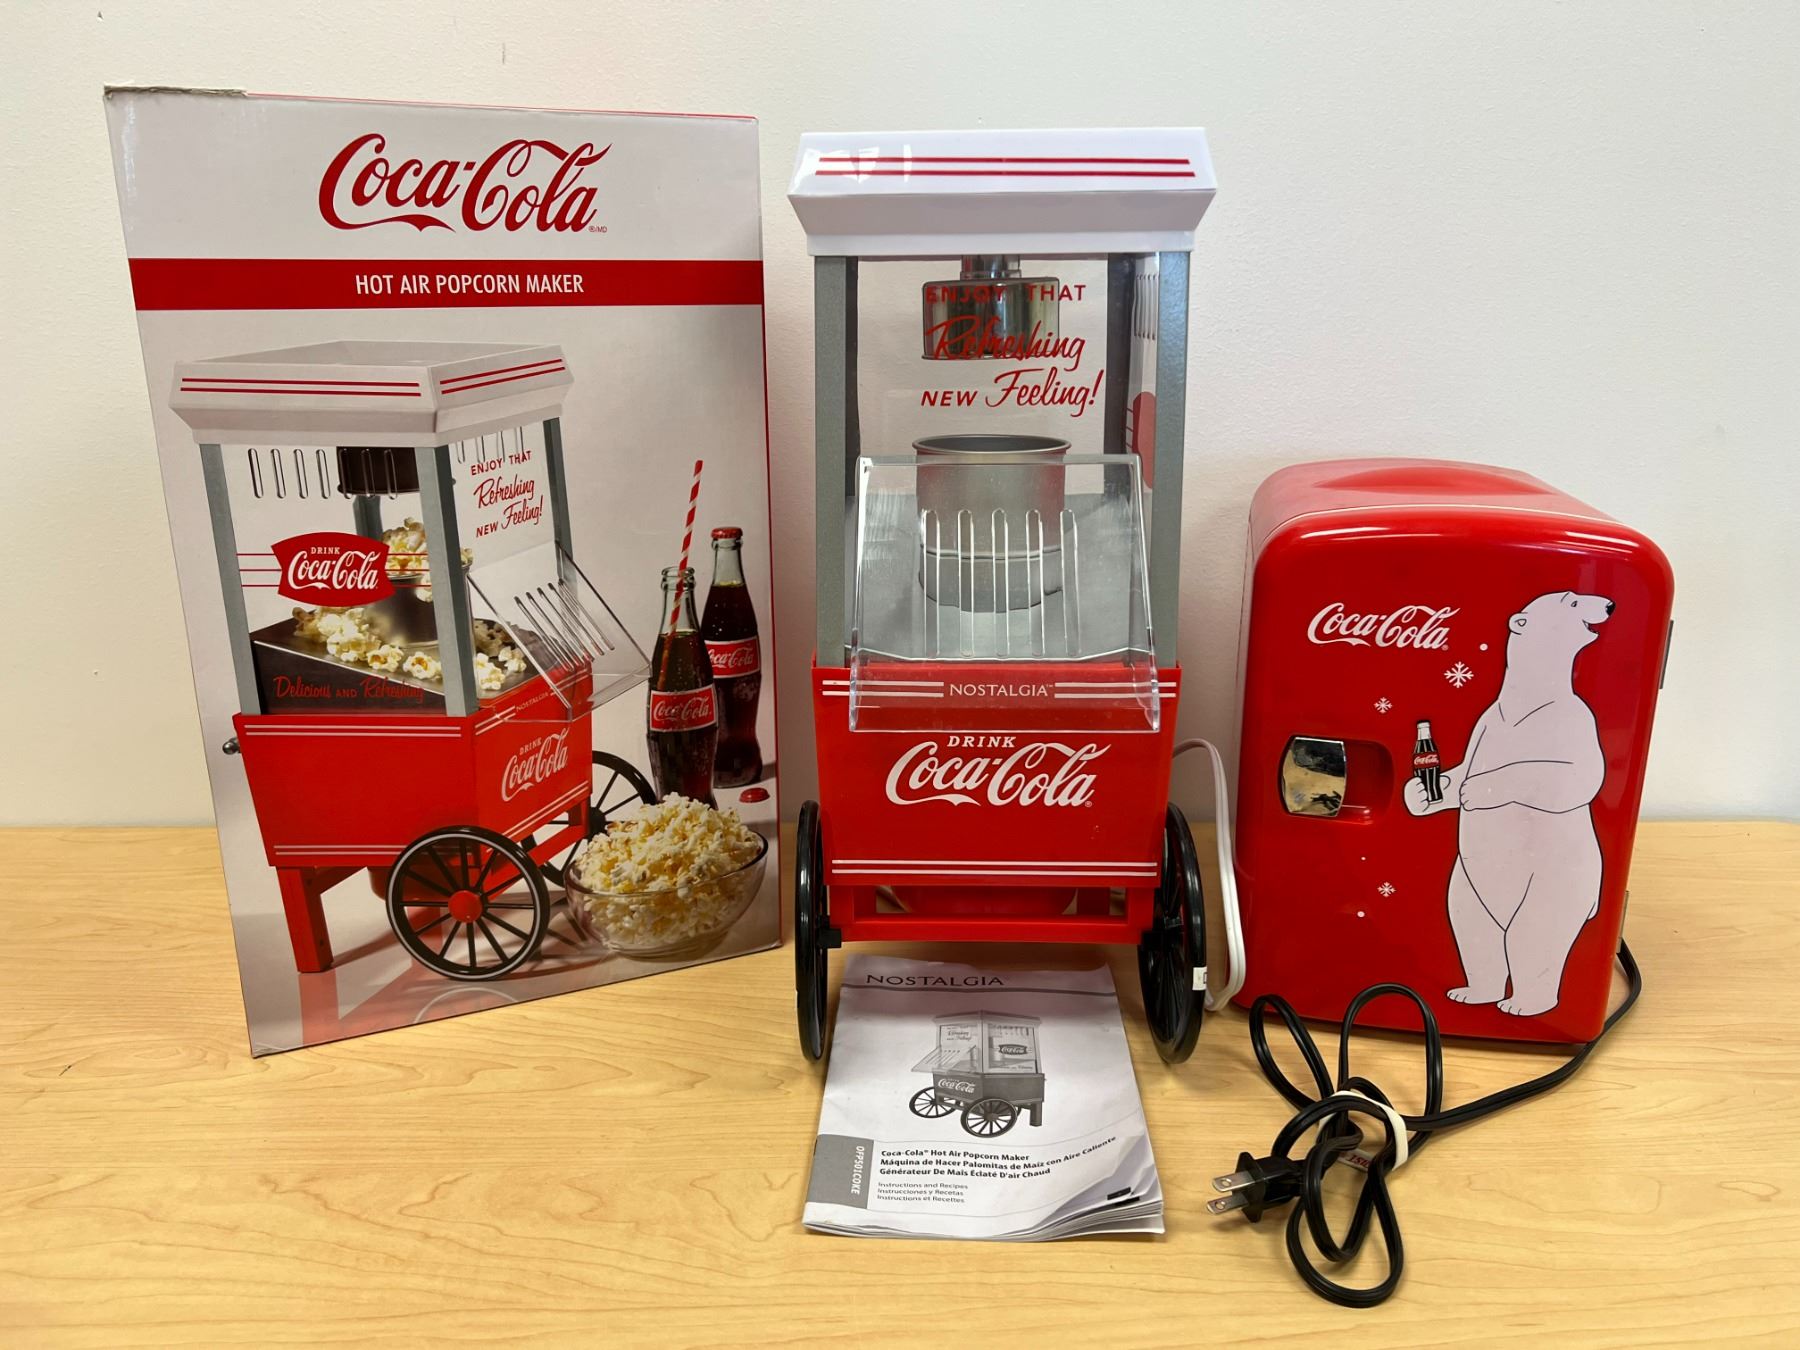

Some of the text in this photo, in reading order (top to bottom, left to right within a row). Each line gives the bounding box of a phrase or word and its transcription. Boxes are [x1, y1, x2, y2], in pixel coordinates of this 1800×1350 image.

[318, 132, 613, 233] Coca-Cola
[355, 274, 585, 295] HOT AIR POPCORN MAKER
[926, 284, 1087, 305] ENJOY THAT
[925, 314, 1086, 372] Refreshing
[920, 366, 1105, 418] NEW Feeling!
[470, 450, 532, 476] ENJOY THAT
[473, 473, 535, 509] Refreshing
[476, 494, 544, 538] NEW Feeling!
[310, 546, 341, 555] DRINK
[288, 550, 382, 591] Coca-Cola
[1307, 602, 1461, 650] Coca-Cola
[273, 675, 331, 699] Delicious
[335, 688, 358, 699] AND
[949, 683, 1051, 698] NOSTALGIA
[519, 736, 543, 756] DRINK
[947, 735, 1017, 749] DRINK
[501, 726, 571, 802] Coca-Cola
[885, 741, 1112, 808] Coca-Cola
[866, 974, 1005, 987] NOSTALGIA
[880, 1159, 920, 1167] Máquina
[935, 1159, 961, 1167] Hacer
[963, 1160, 1008, 1170] Palomitas
[1046, 1158, 1062, 1166] con
[1063, 1152, 1081, 1162] Aire
[1082, 1136, 1116, 1155] Caliente
[930, 1149, 947, 1157] Hot
[948, 1150, 961, 1158] Air
[963, 1151, 999, 1162] Popcorn
[879, 1168, 932, 1176] Générateur
[933, 1168, 946, 1176] De
[970, 1169, 998, 1179] Éclaté
[1022, 1168, 1051, 1178] Chaud
[932, 1196, 965, 1204] Recettes
[934, 1189, 964, 1197] Recetas
